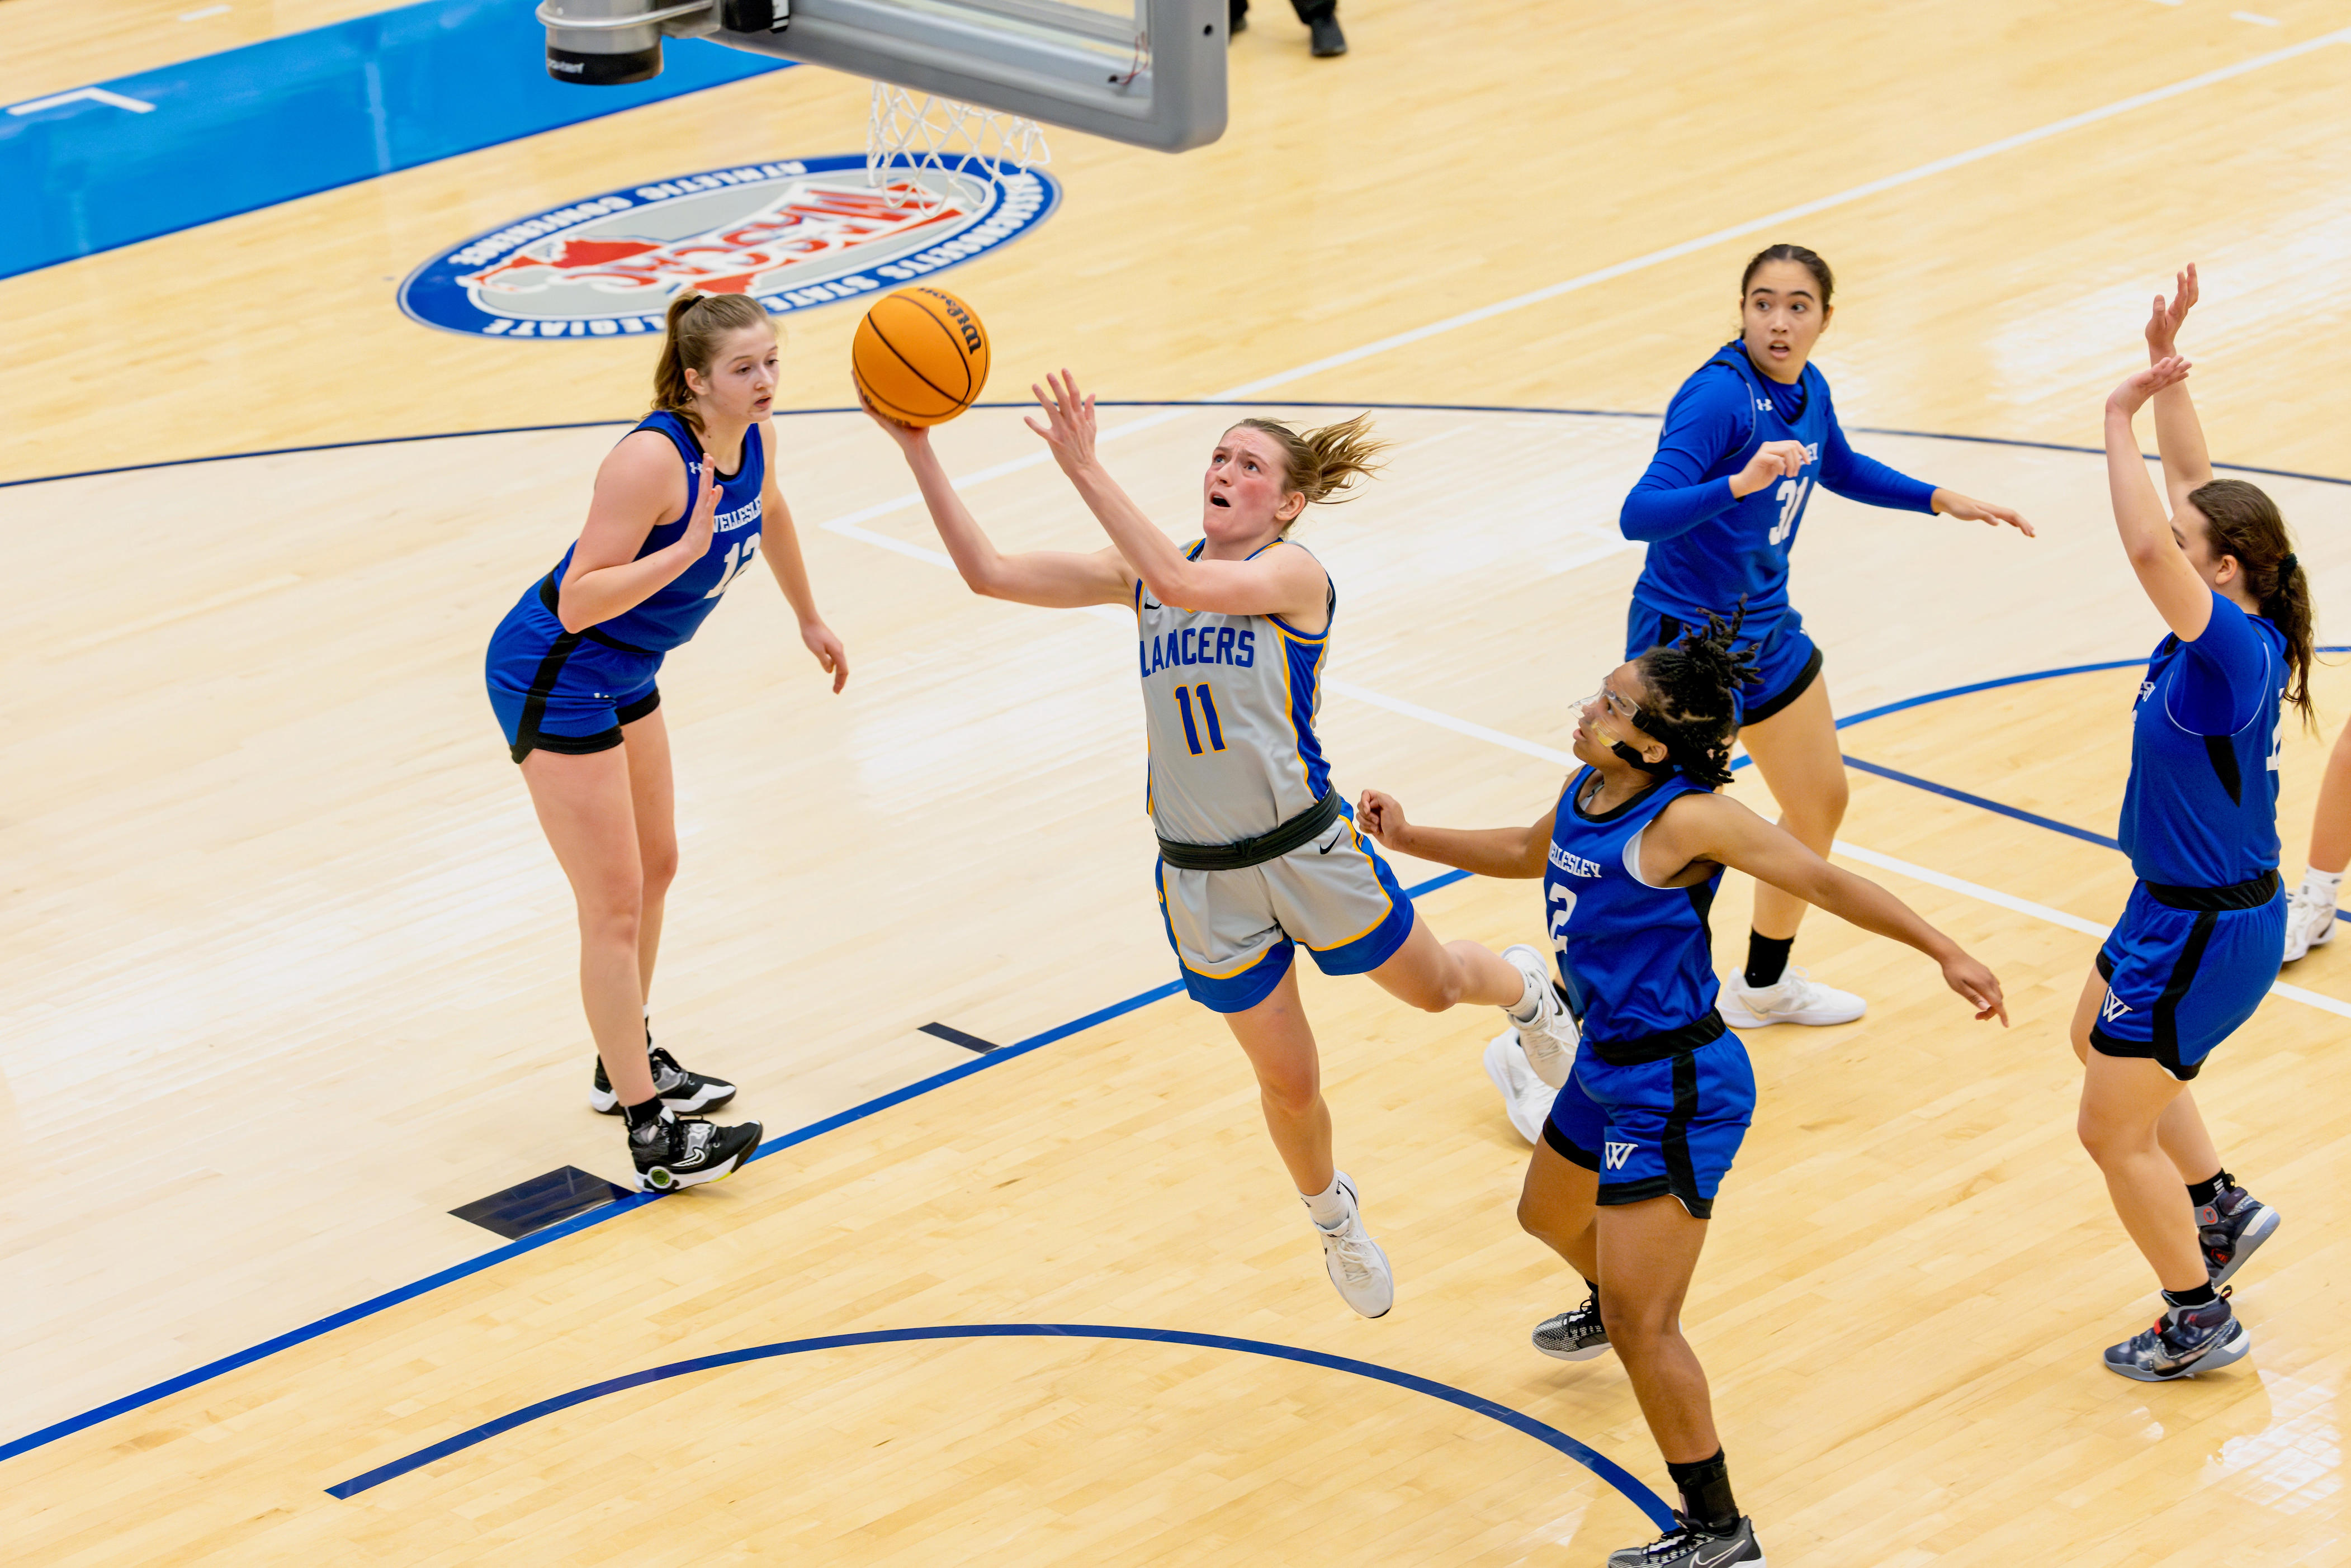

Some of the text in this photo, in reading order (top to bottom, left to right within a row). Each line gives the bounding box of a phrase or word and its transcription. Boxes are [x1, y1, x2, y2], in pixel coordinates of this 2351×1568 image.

[448, 160, 808, 266] ATHLETIC CONFERENCE
[757, 275, 880, 311] STATE
[1768, 476, 1809, 546] 31
[703, 532, 761, 599] 12
[1139, 626, 1255, 678] LANCERS
[1174, 681, 1228, 757] 11
[1549, 882, 1577, 954] 2
[2102, 986, 2133, 1022] W
[1605, 1141, 1639, 1170] W
